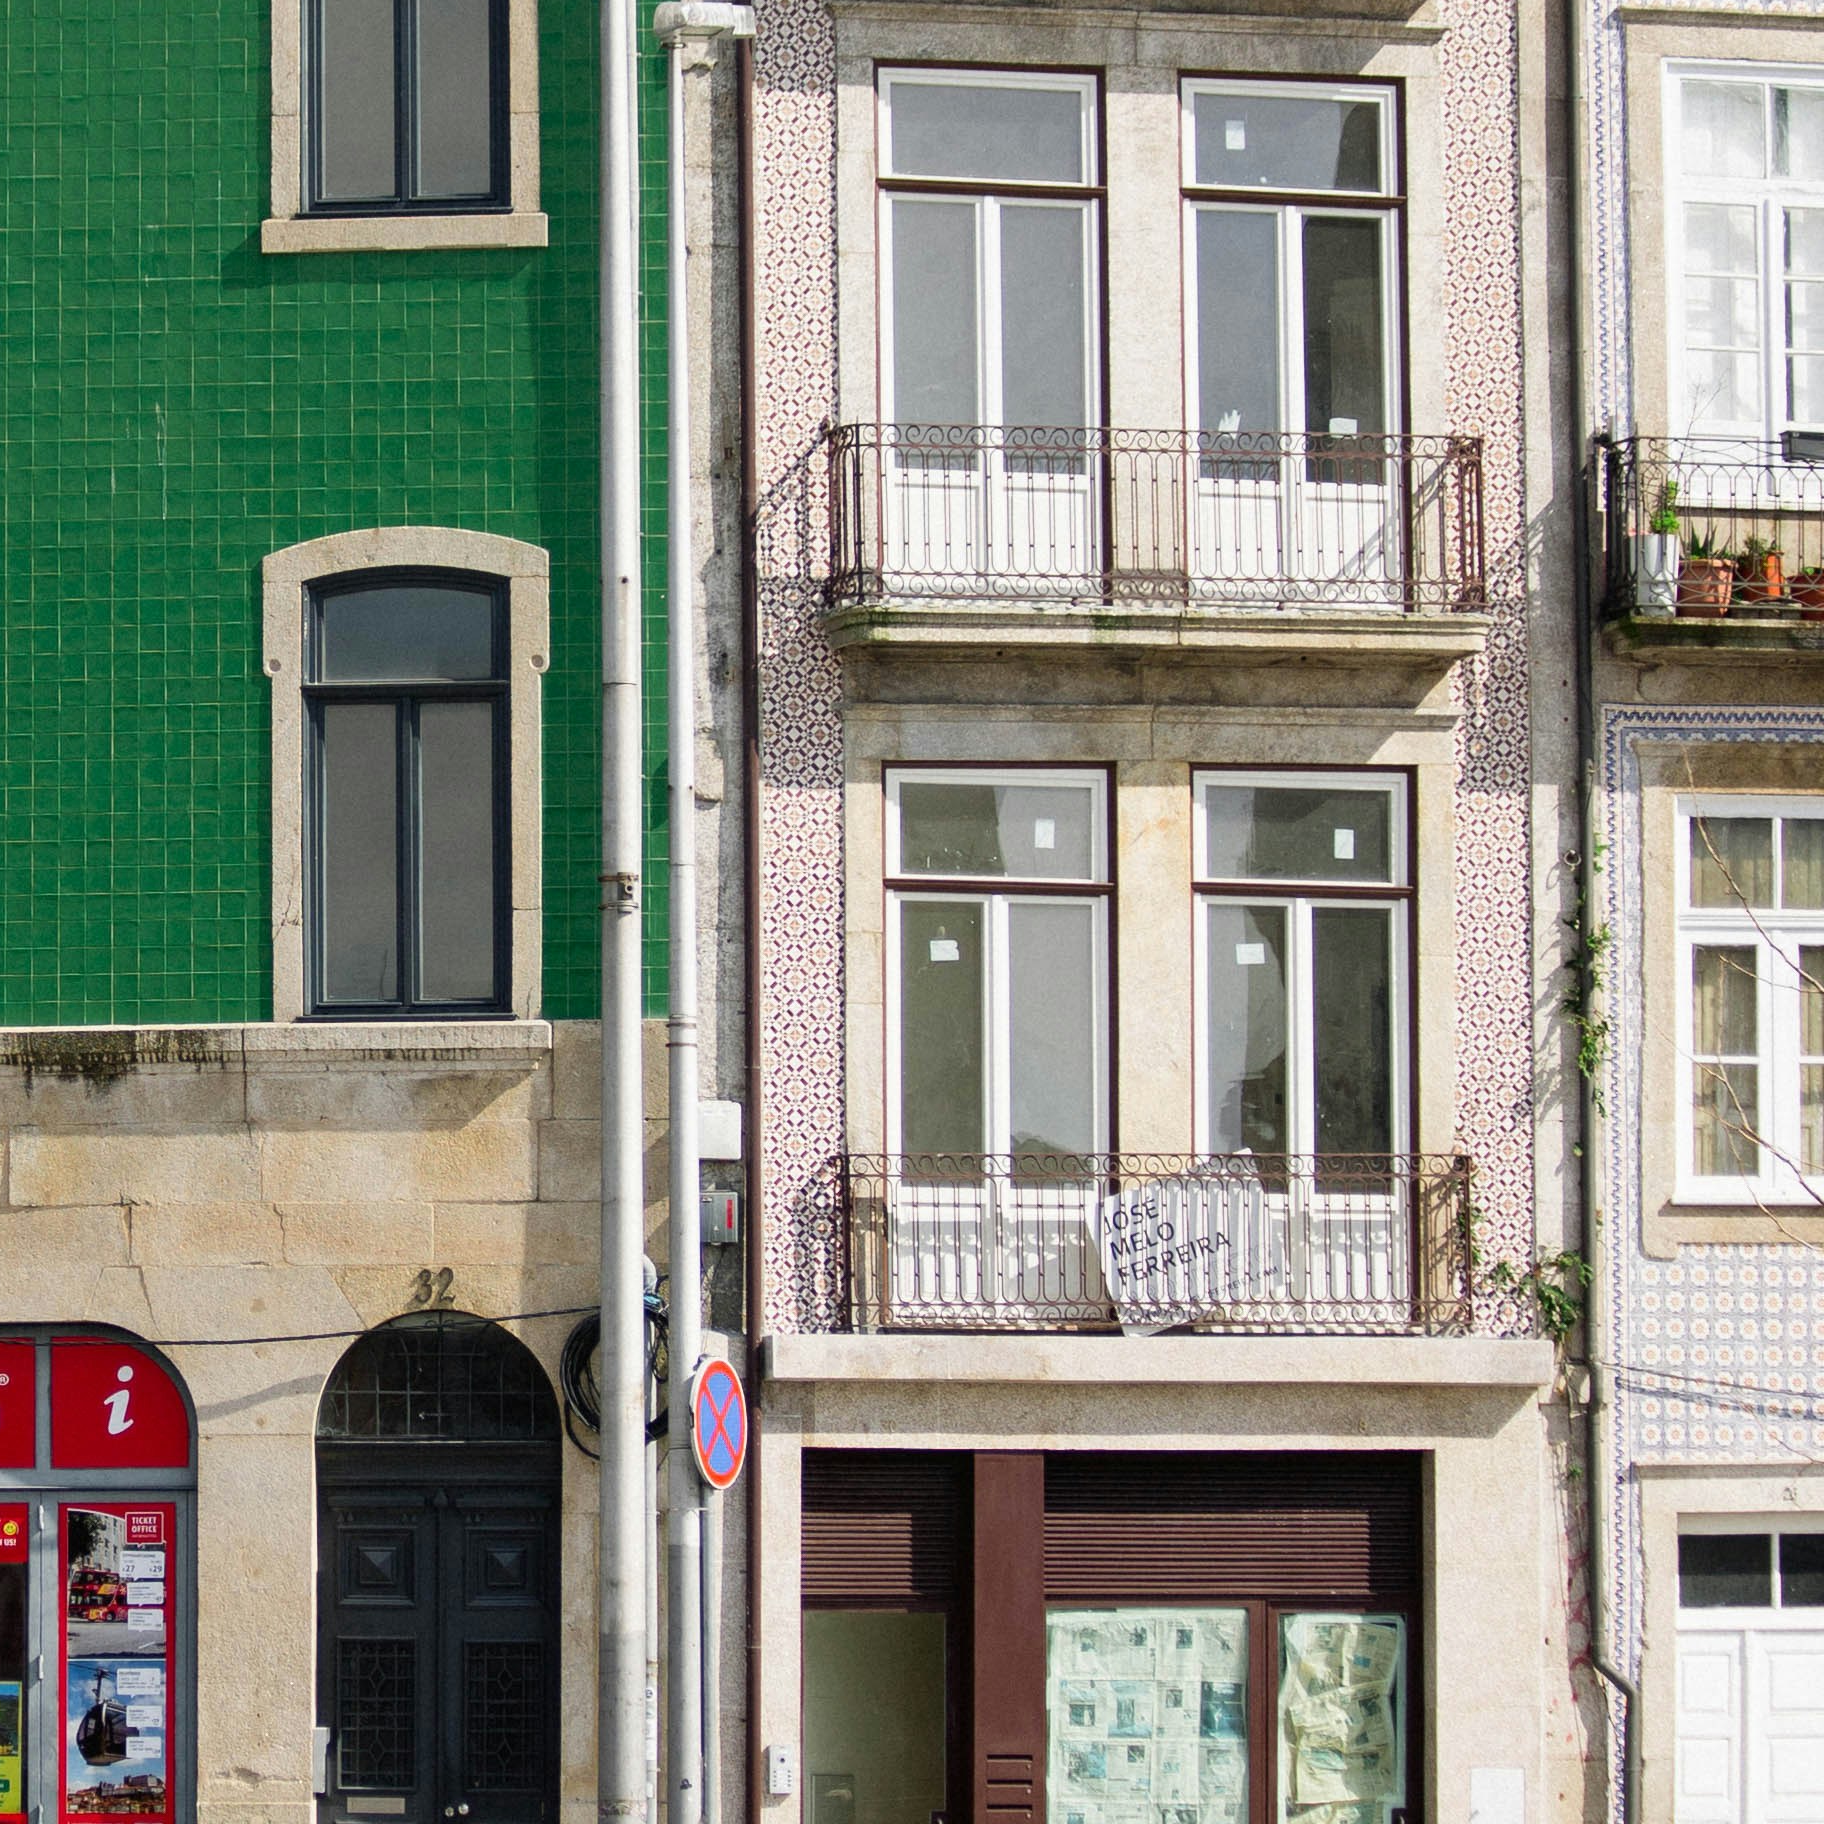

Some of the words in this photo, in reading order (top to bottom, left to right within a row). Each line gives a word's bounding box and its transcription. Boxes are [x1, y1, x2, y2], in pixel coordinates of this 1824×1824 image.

[1105, 1196, 1159, 1235] JOSÉ
[1110, 1222, 1175, 1261] MELO
[1118, 1231, 1232, 1286] FERREIRA
[414, 1267, 456, 1303] 32
[131, 1516, 157, 1525] TICKET
[131, 1525, 157, 1533] OFFICE
